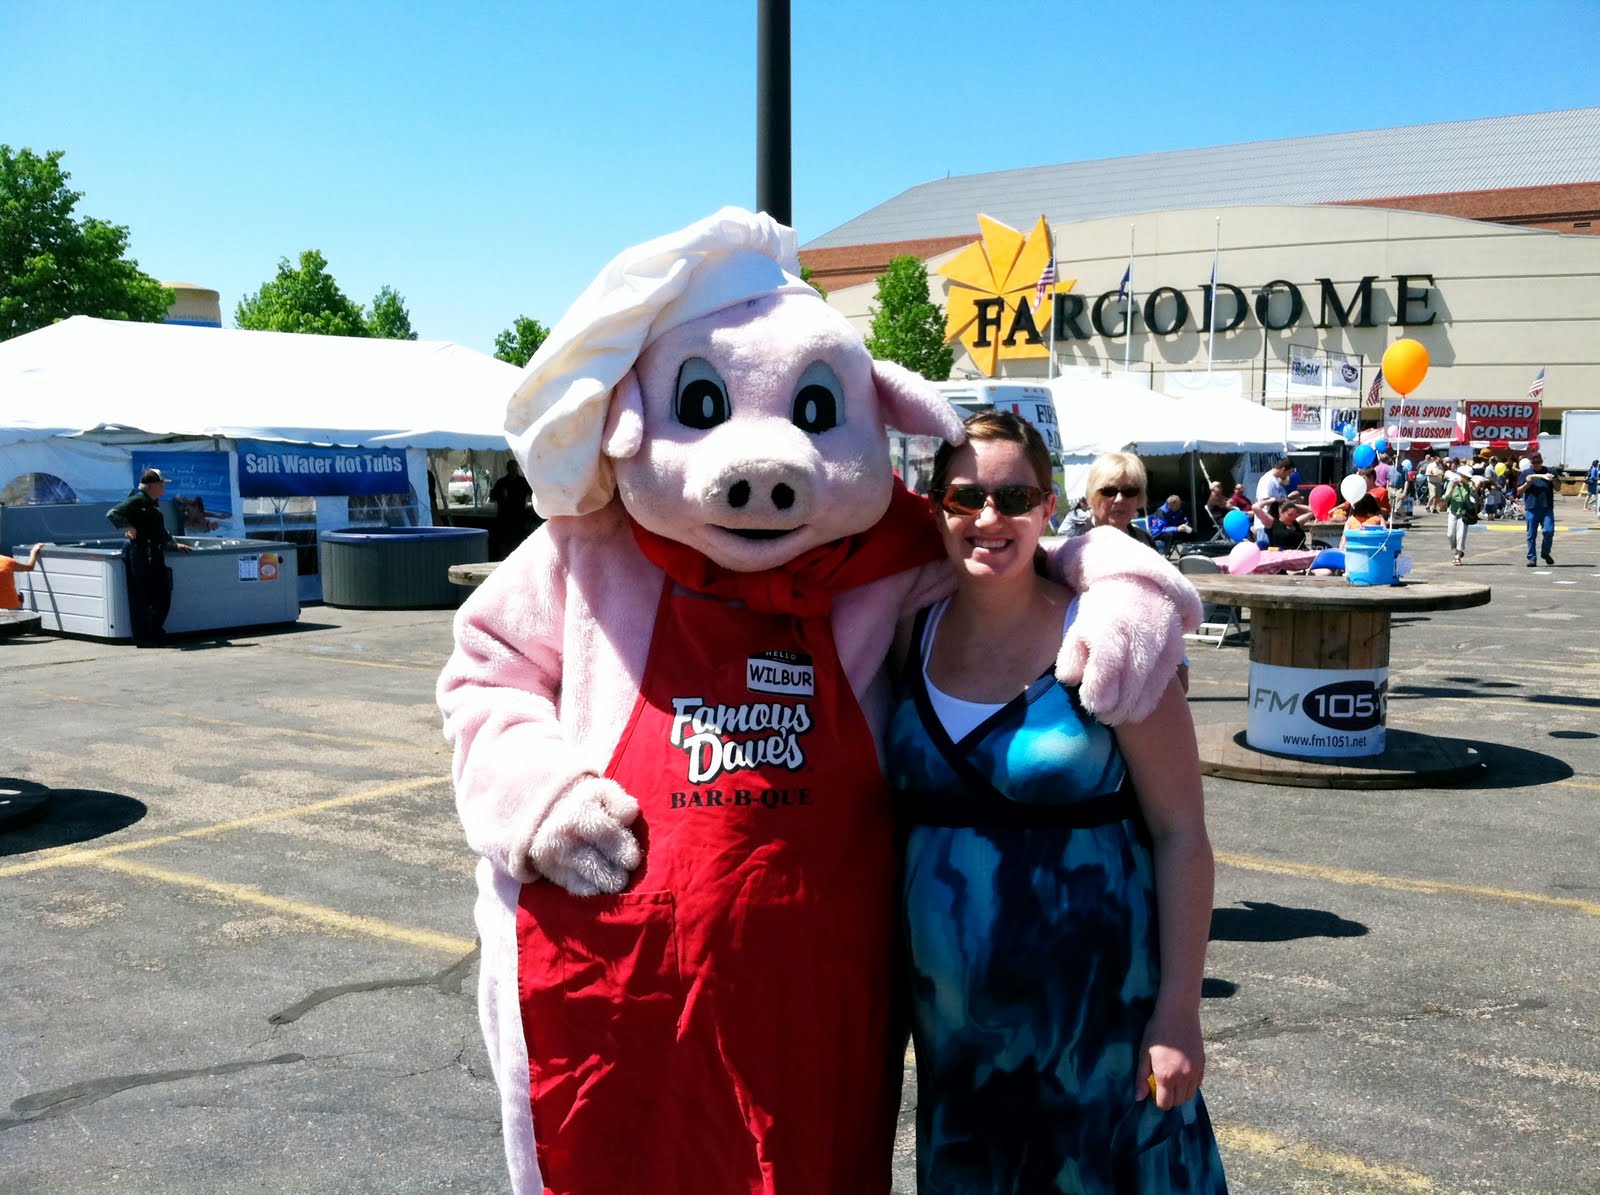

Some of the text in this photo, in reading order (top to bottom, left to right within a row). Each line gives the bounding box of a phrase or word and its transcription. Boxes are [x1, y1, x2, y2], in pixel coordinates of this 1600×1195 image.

[973, 274, 1437, 347] FARGODOME
[1422, 405, 1452, 418] SPUDS
[1470, 404, 1533, 418] ROASTED
[1415, 427, 1453, 438] BLOSSOM
[1472, 425, 1529, 440] CORN
[245, 453, 403, 474] Salt Water Hot Tubs
[765, 651, 797, 660] HELLO
[750, 664, 812, 686] WILBUR
[1254, 687, 1300, 715] FM
[669, 697, 811, 746] Famous
[1282, 734, 1367, 748] www.fm1051.net
[682, 727, 804, 783] Dave's
[671, 788, 814, 809] BAR-B-QUE
